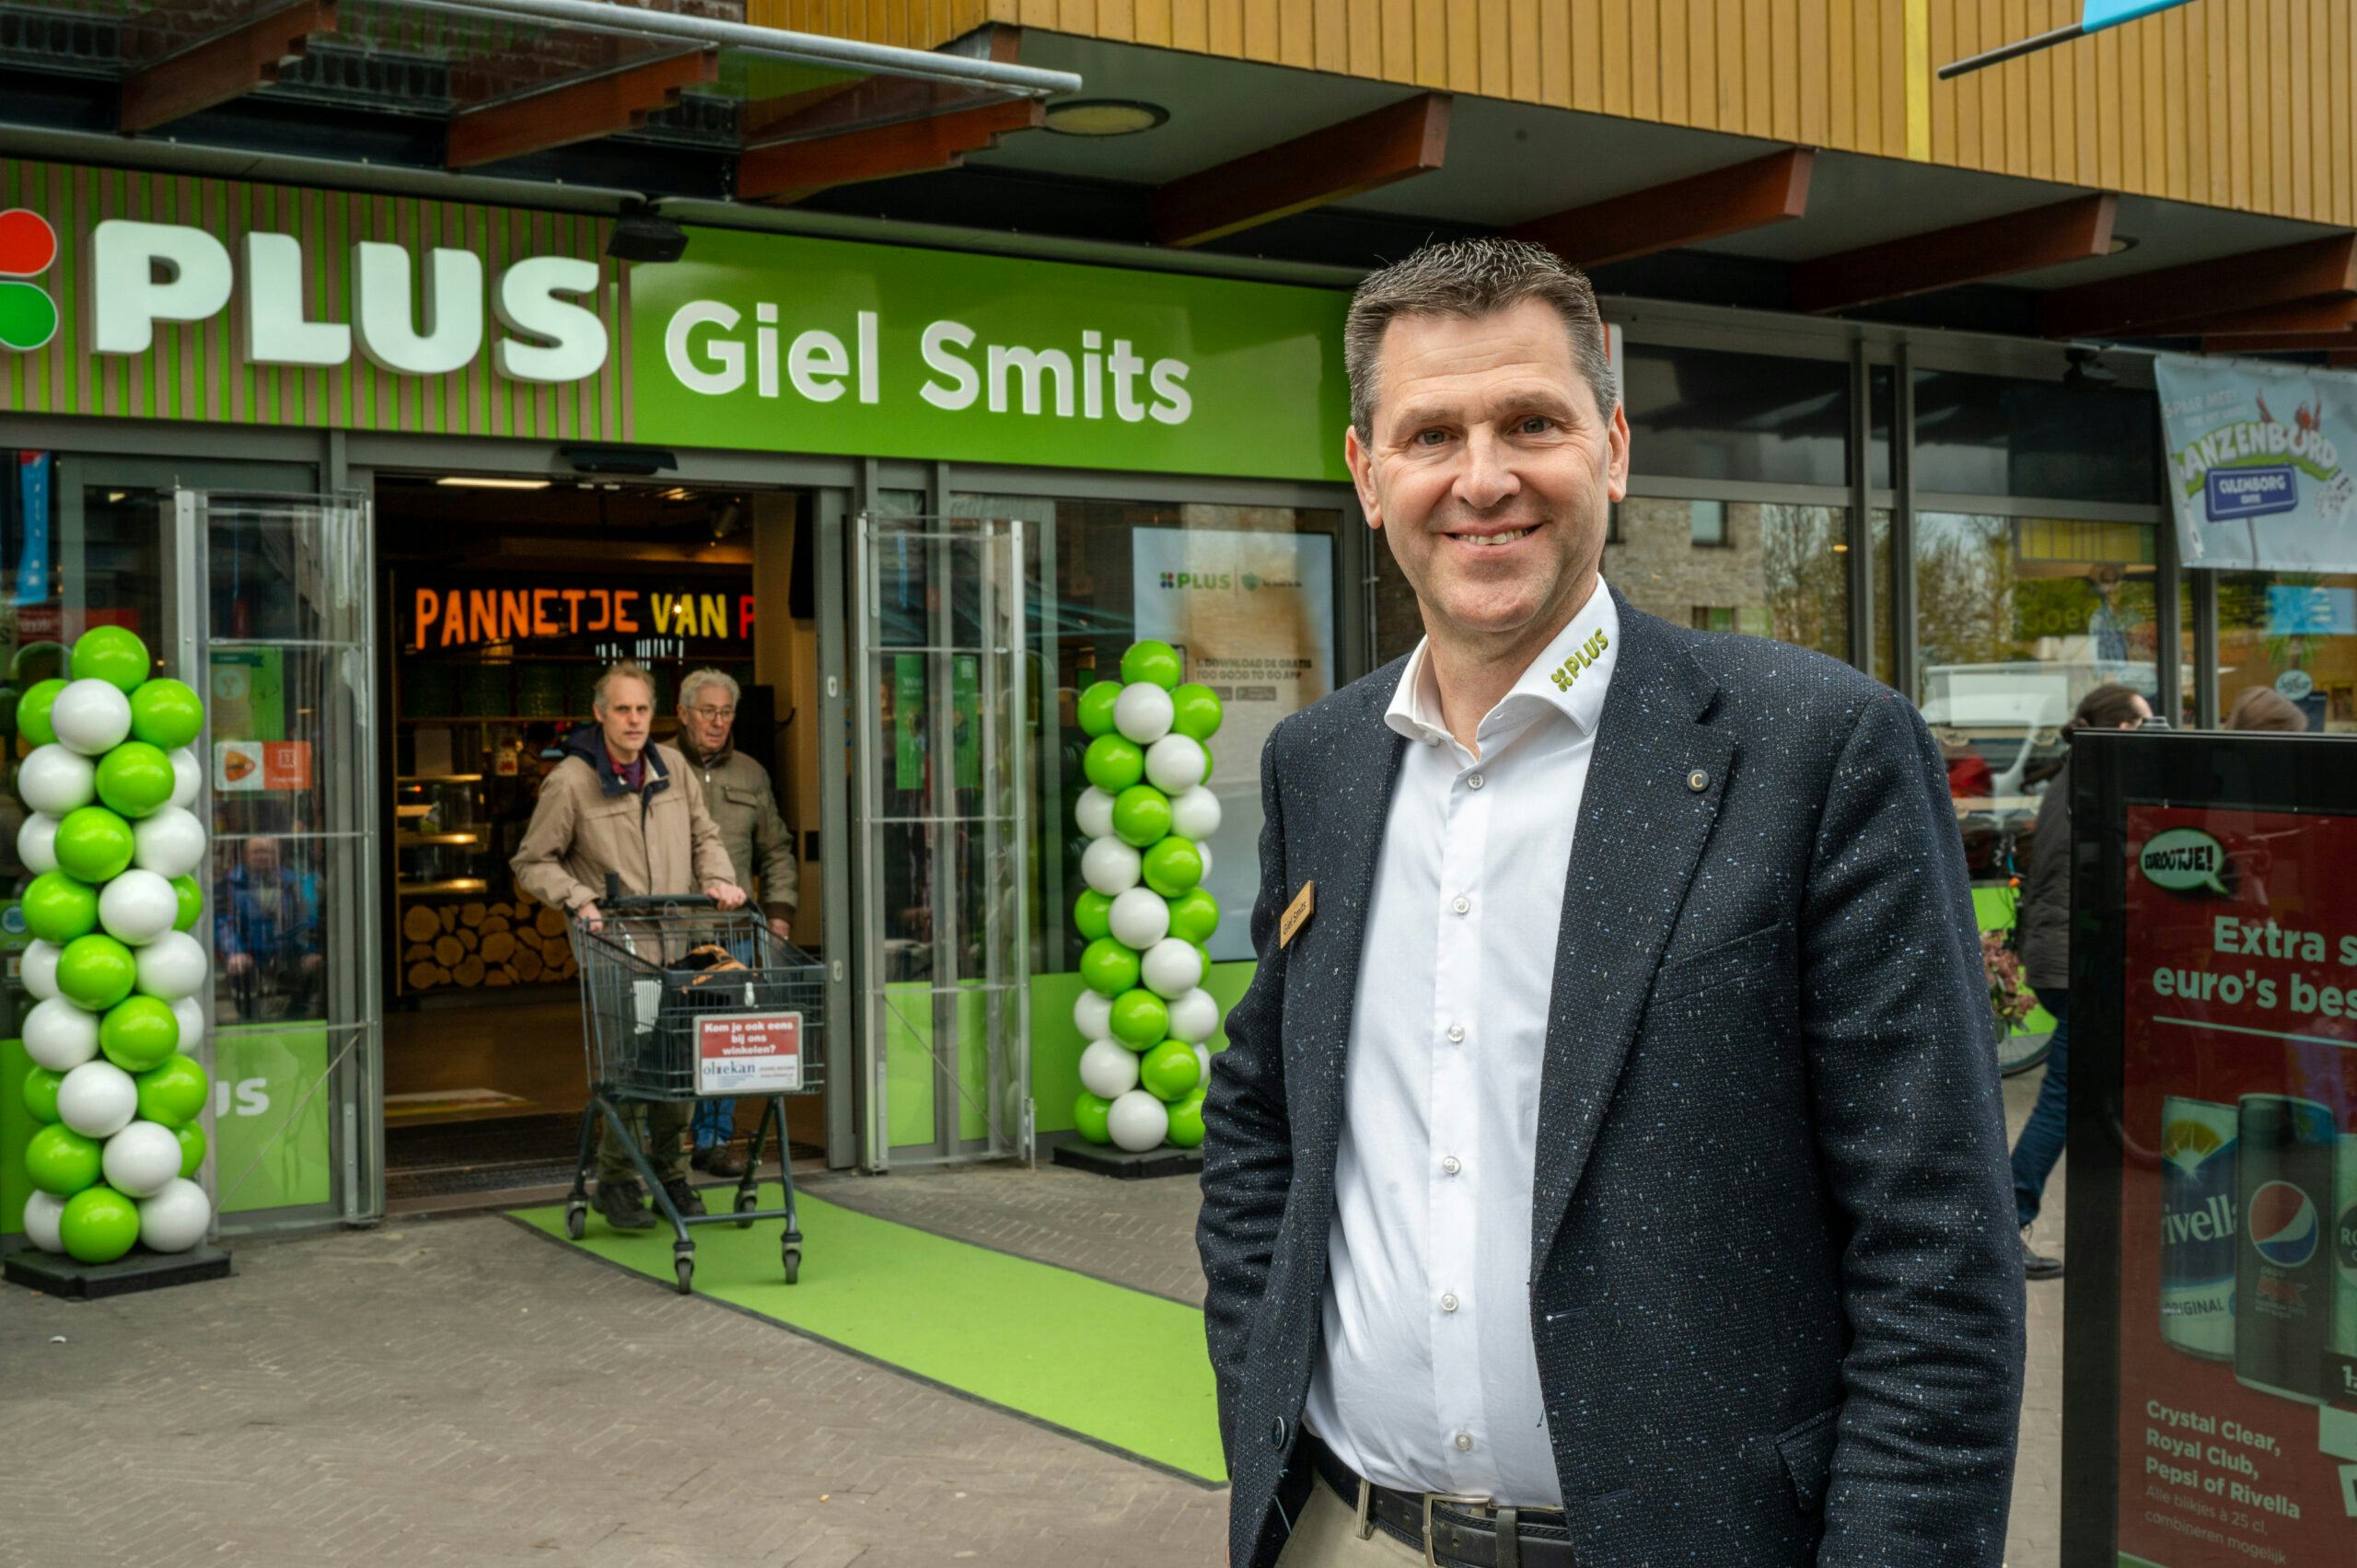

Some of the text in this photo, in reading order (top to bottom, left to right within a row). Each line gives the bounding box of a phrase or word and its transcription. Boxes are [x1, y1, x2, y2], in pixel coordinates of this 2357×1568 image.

[92, 219, 609, 384] PLUS
[665, 300, 1192, 425] Giel Smits
[1177, 573, 1231, 588] PLUS
[415, 587, 639, 650] PANNETJE
[650, 592, 728, 639] VAN
[1563, 627, 1608, 679] PLUS
[2214, 915, 2326, 963] Extra
[704, 1023, 729, 1033] Kom
[731, 1022, 742, 1034] je
[745, 1022, 765, 1032] ook
[731, 1034, 767, 1045] bij ons
[2146, 1400, 2282, 1458] Crystal Clear,
[2146, 1428, 2259, 1481] Royal Club,
[2145, 1456, 2199, 1489] Pepsi
[2203, 1477, 2224, 1496] of
[2230, 1481, 2301, 1520] Rivella
[2145, 1484, 2171, 1504] Alle
[2173, 1493, 2216, 1519] blikjes
[2219, 1506, 2228, 1522] à
[2231, 1511, 2249, 1529] 25
[2143, 1510, 2287, 1565] combineren mogelijk
